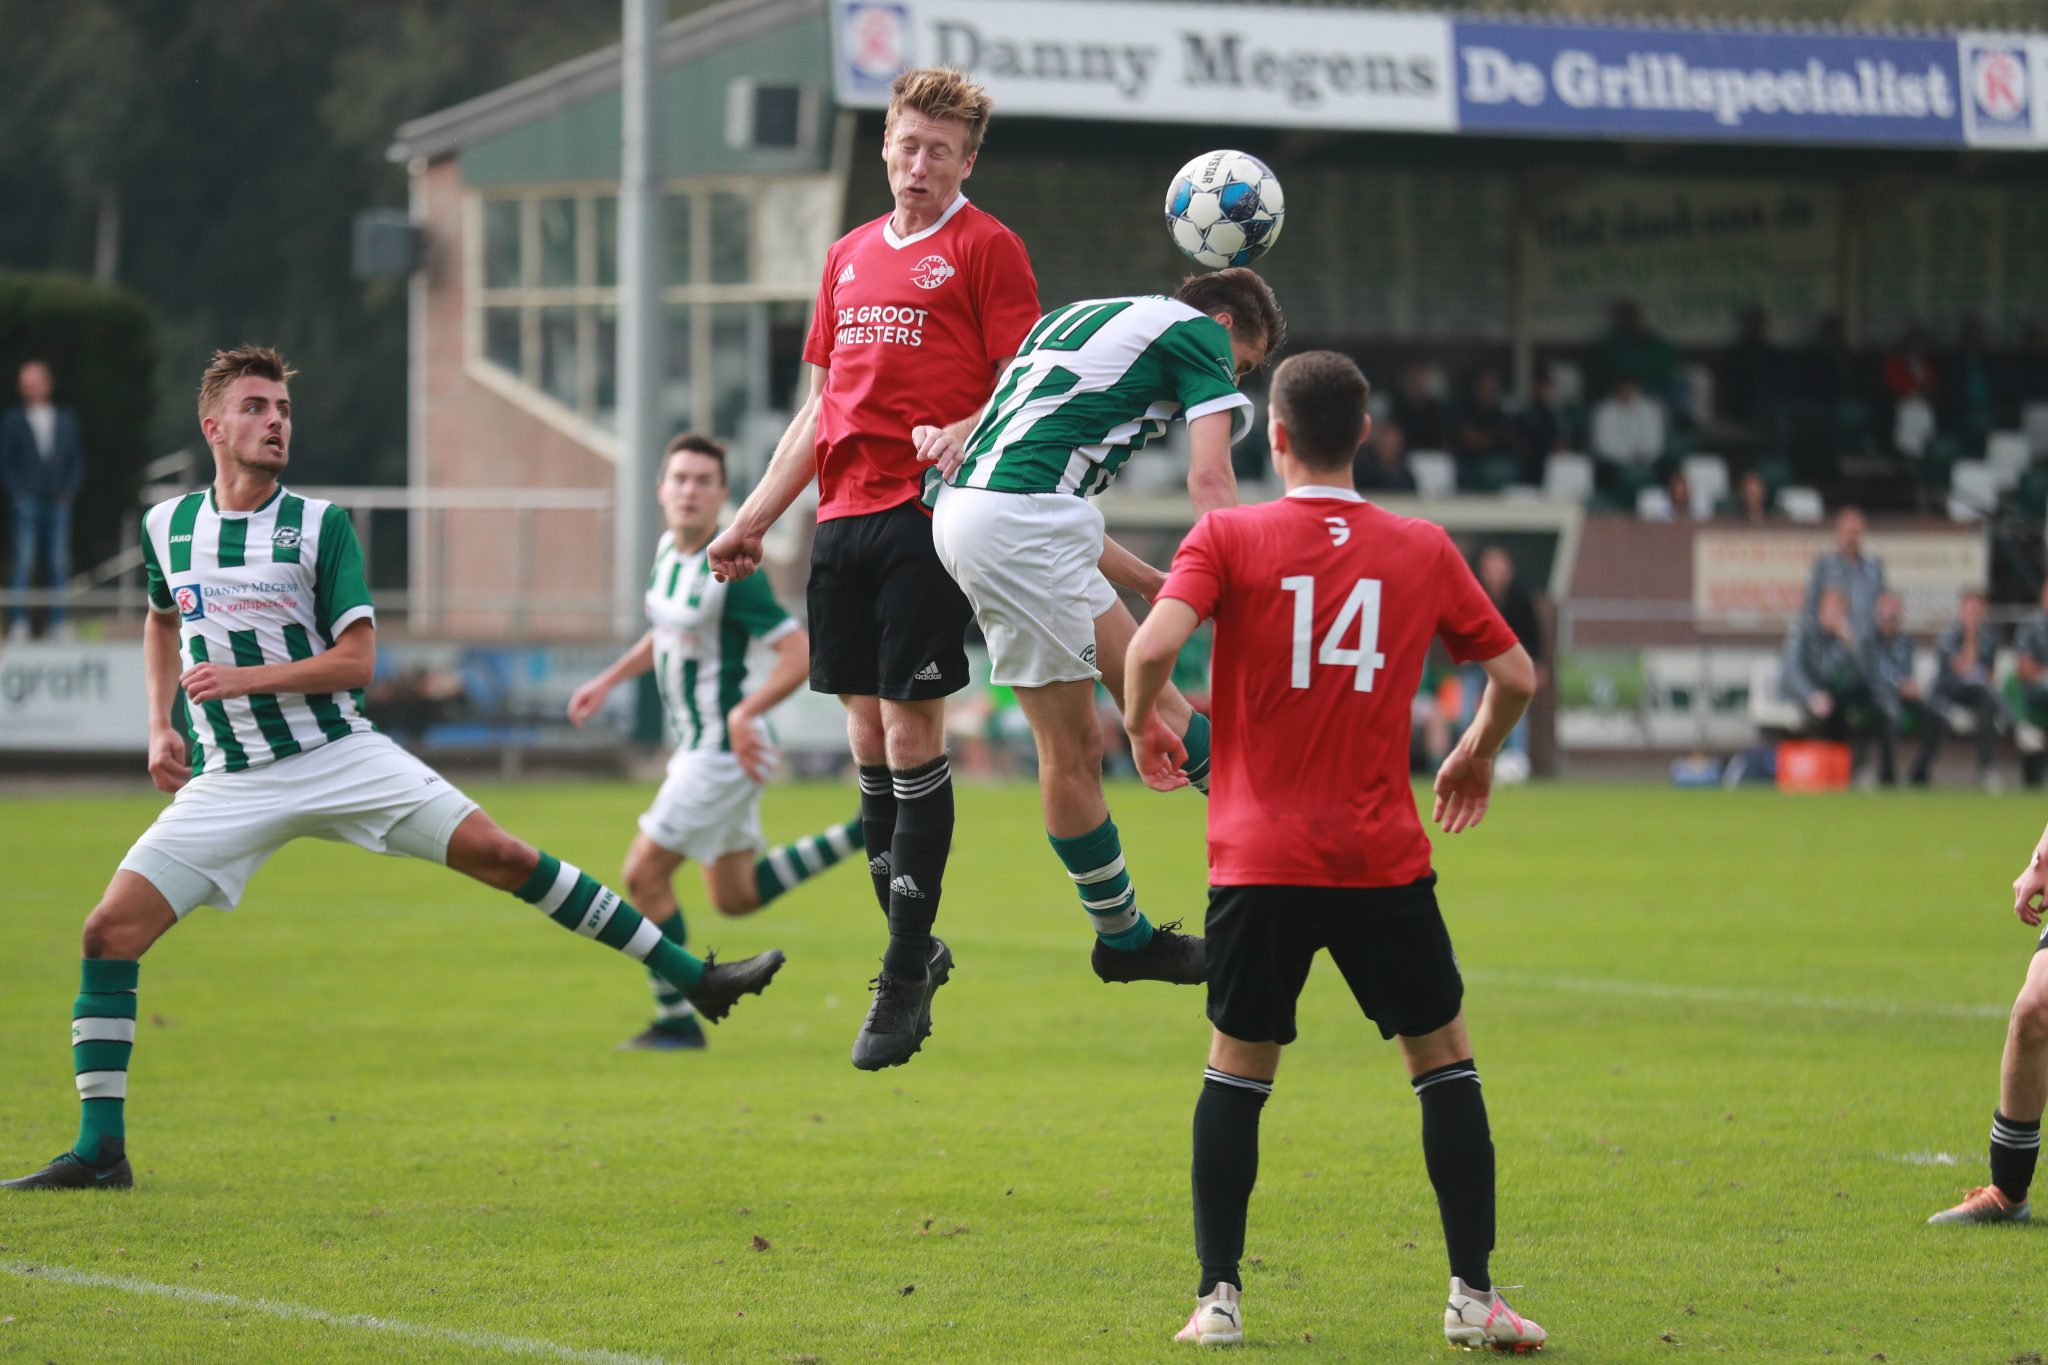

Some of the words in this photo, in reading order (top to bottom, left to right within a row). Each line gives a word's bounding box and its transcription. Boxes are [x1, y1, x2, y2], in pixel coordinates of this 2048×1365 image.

[931, 19, 1158, 98] Danny
[1179, 32, 1437, 109] Megens
[1461, 46, 1545, 106] De
[1552, 50, 1956, 126] Grillspecialist
[838, 308, 854, 326] DE
[857, 305, 928, 327] GROOT
[838, 325, 923, 347] MEESTERS
[169, 534, 192, 544] JAKO
[204, 583, 249, 597] DANNY
[208, 603, 222, 613] De
[1281, 575, 1386, 692] 14
[890, 881, 925, 899] adidas
